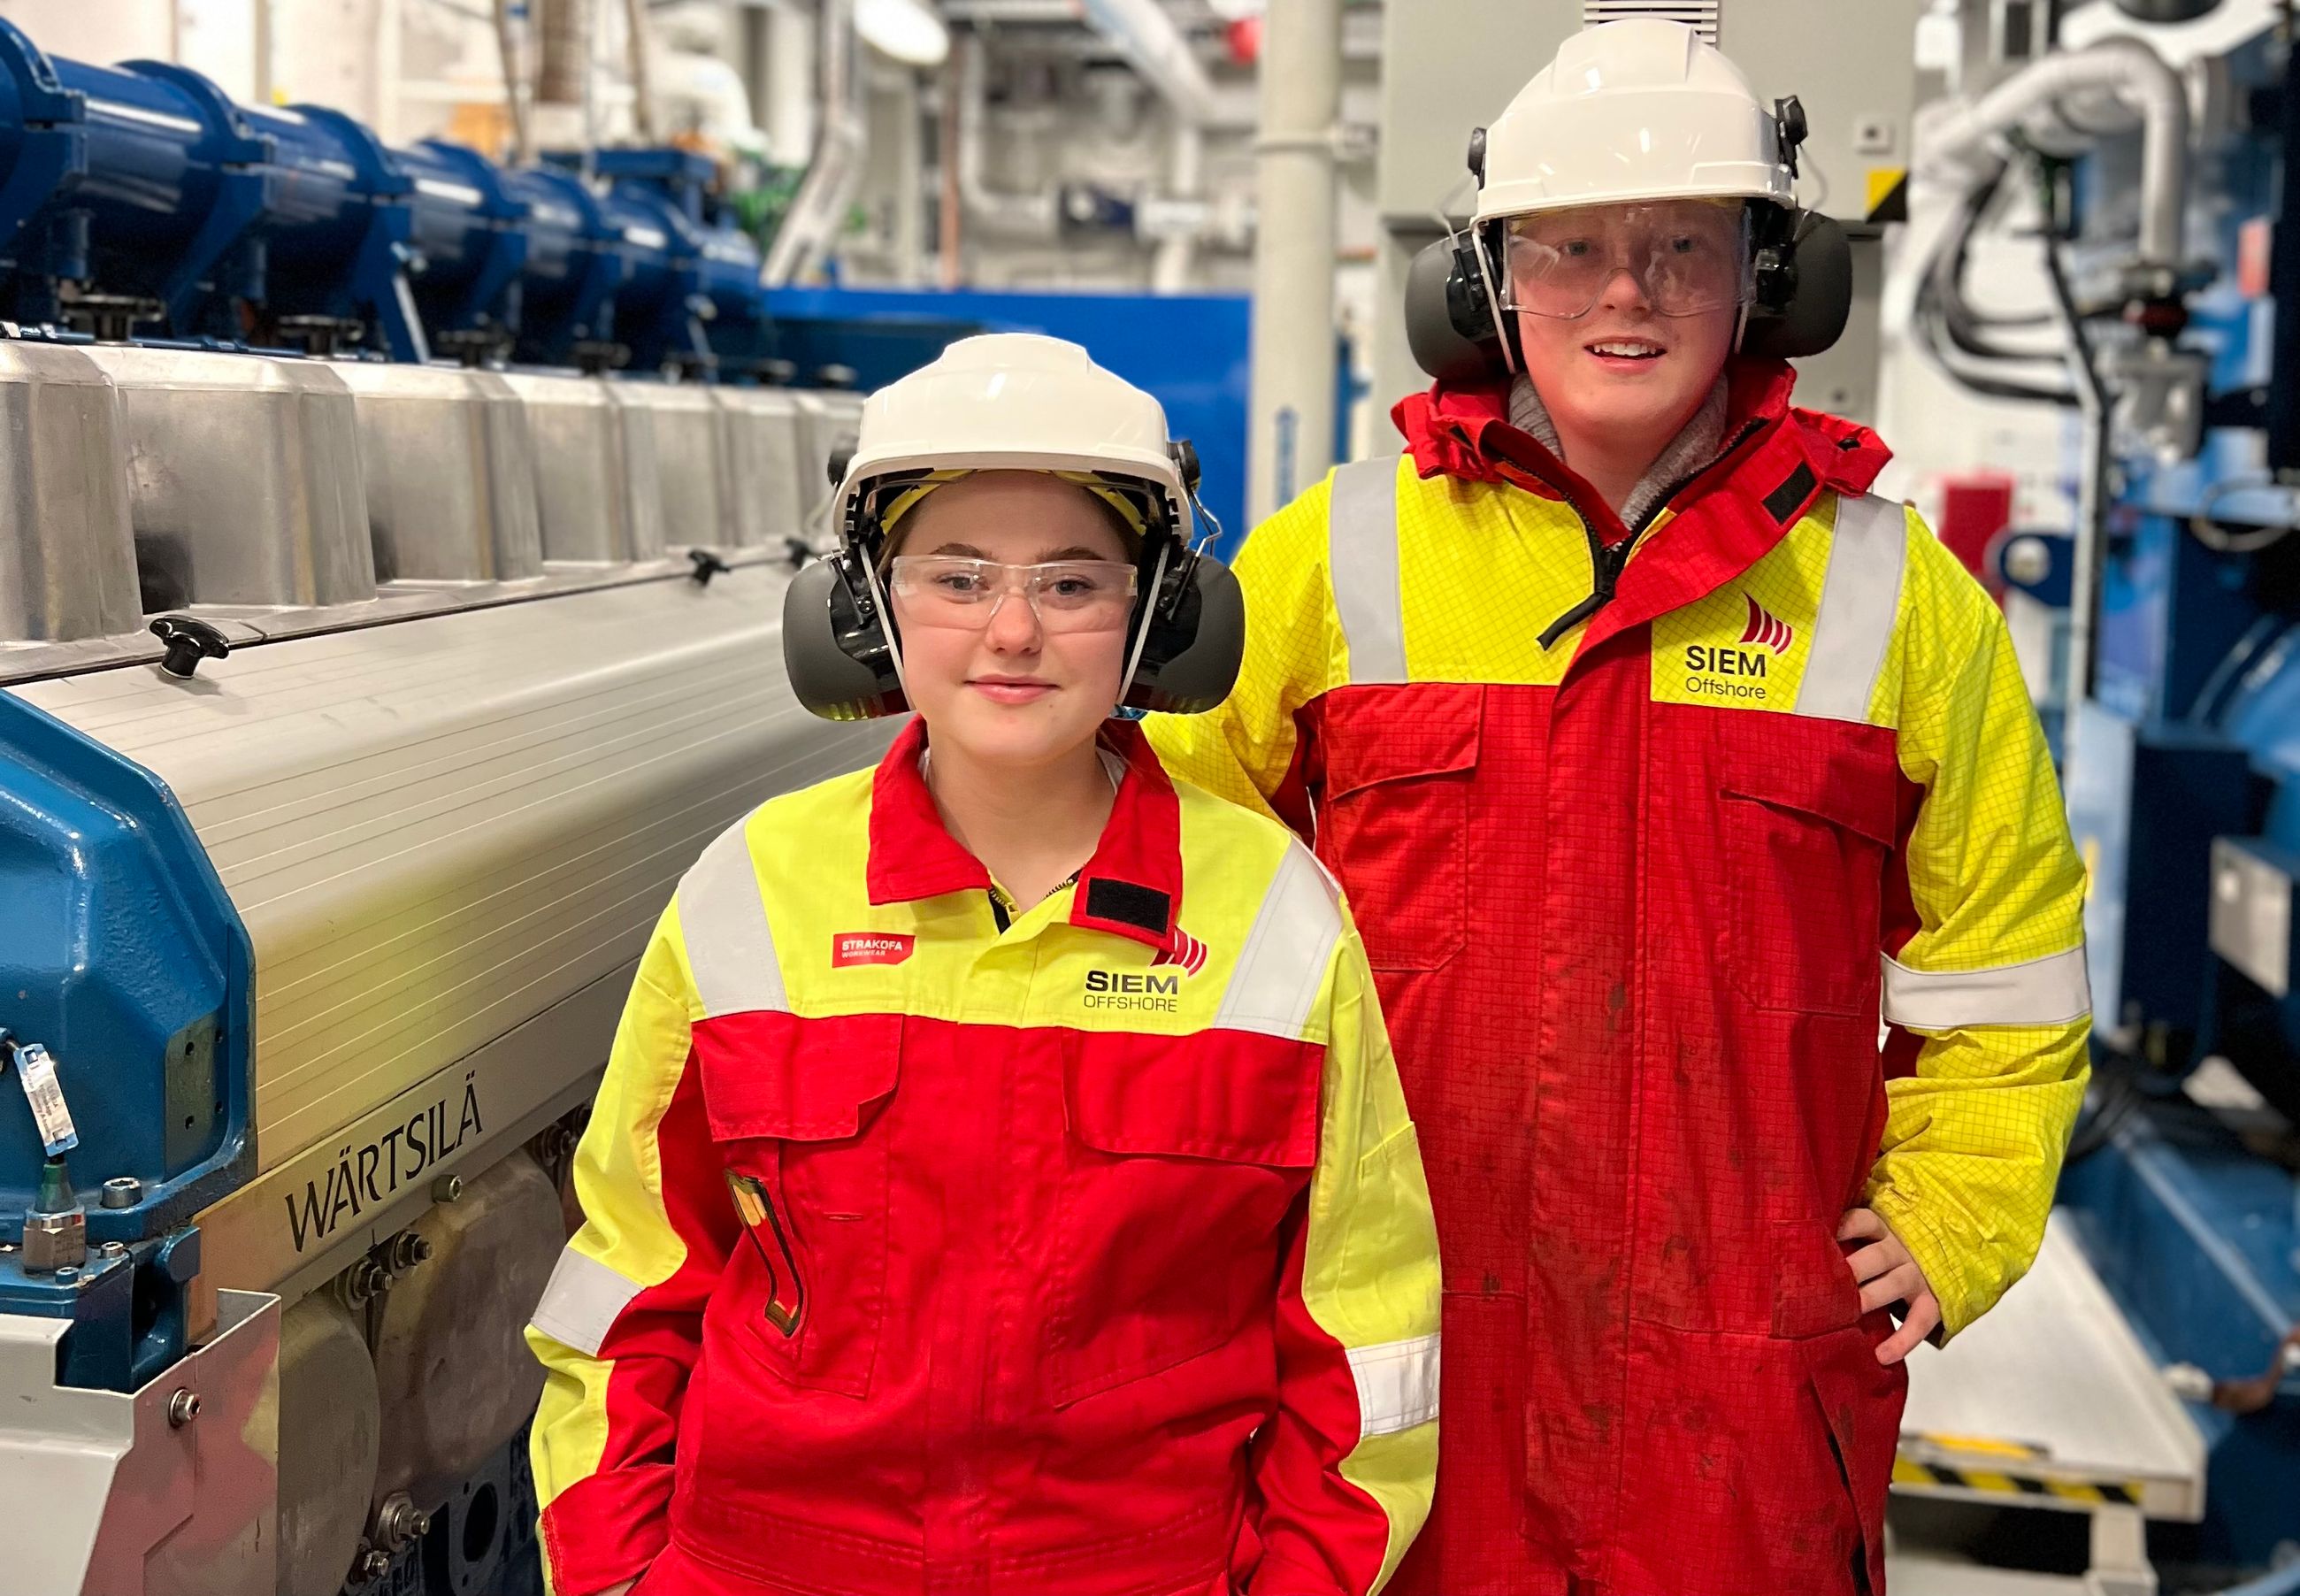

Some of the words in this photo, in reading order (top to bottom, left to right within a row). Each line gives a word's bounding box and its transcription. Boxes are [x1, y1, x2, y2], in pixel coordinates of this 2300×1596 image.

[1685, 645, 1766, 678] SIEM
[1686, 677, 1767, 700] Offshore
[842, 940, 902, 951] STRAKOFA
[1085, 971, 1178, 995] SIEM
[1084, 994, 1177, 1013] OFFSHORE
[285, 1070, 483, 1253] WÄRTSILÄ
